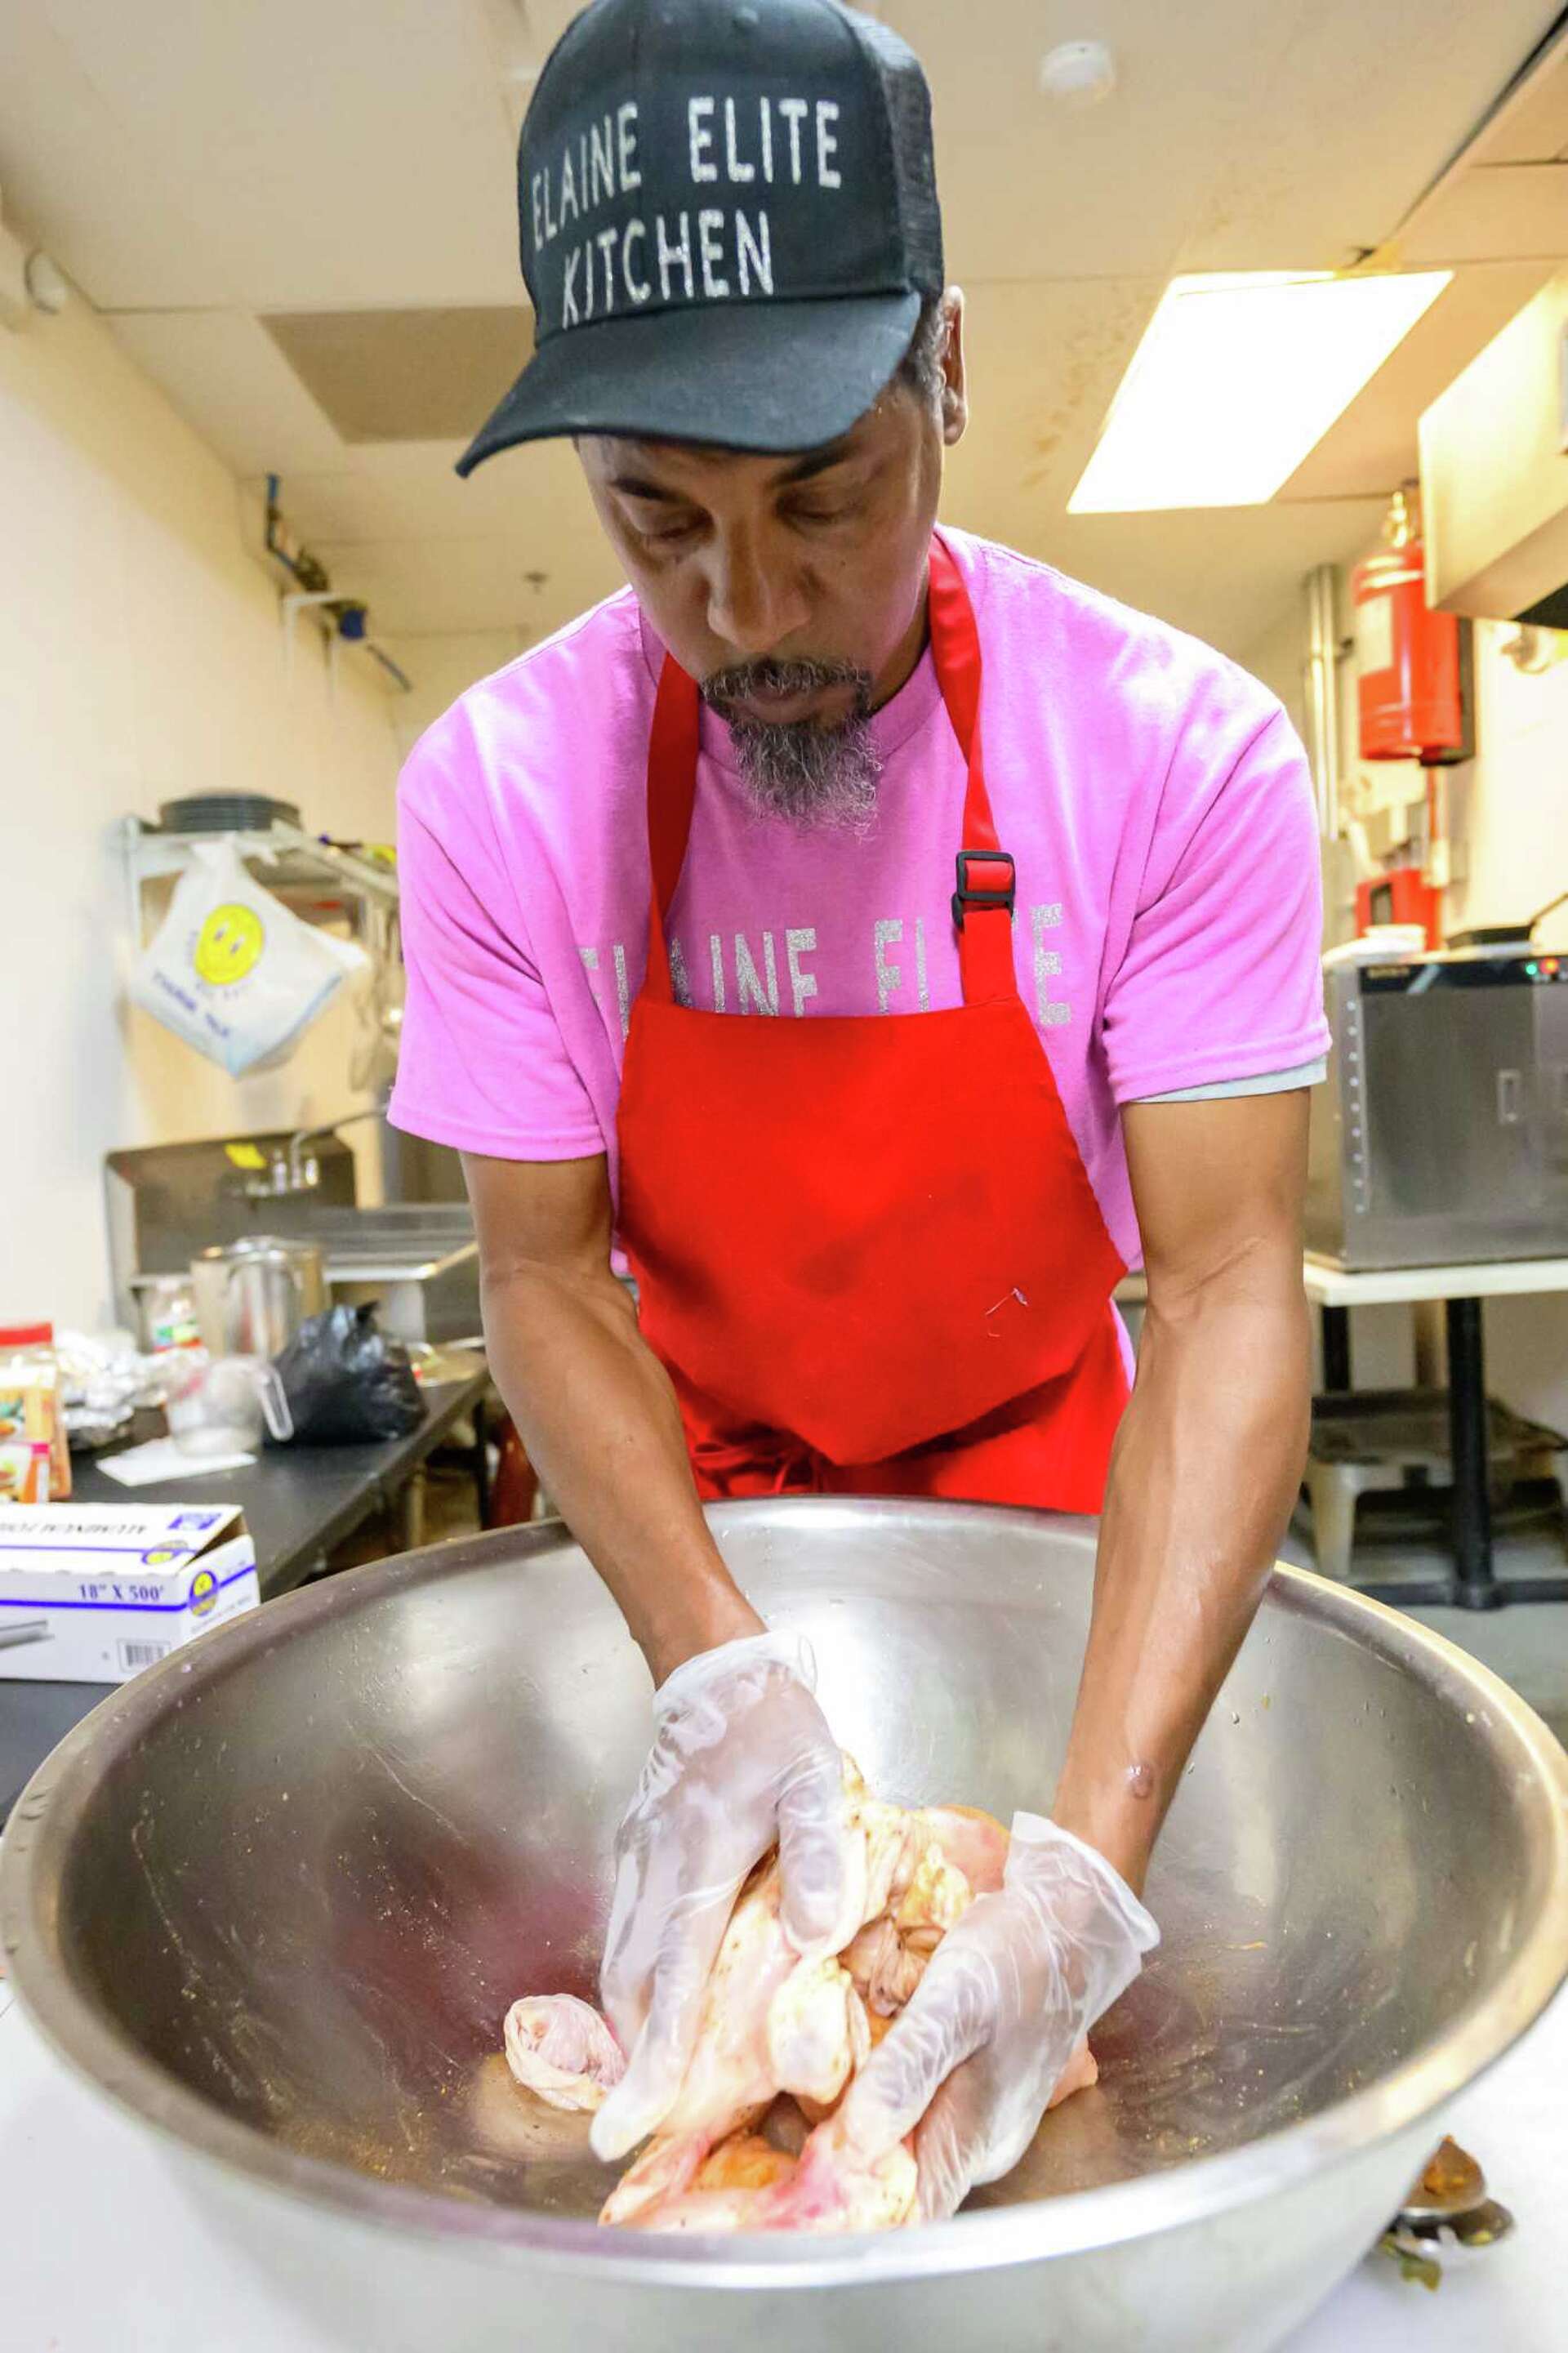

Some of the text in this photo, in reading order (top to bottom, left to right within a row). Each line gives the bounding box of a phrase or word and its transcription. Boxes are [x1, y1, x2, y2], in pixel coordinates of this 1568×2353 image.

[532, 96, 842, 251] ELAINE ELITE
[562, 208, 774, 330] KITCHEN
